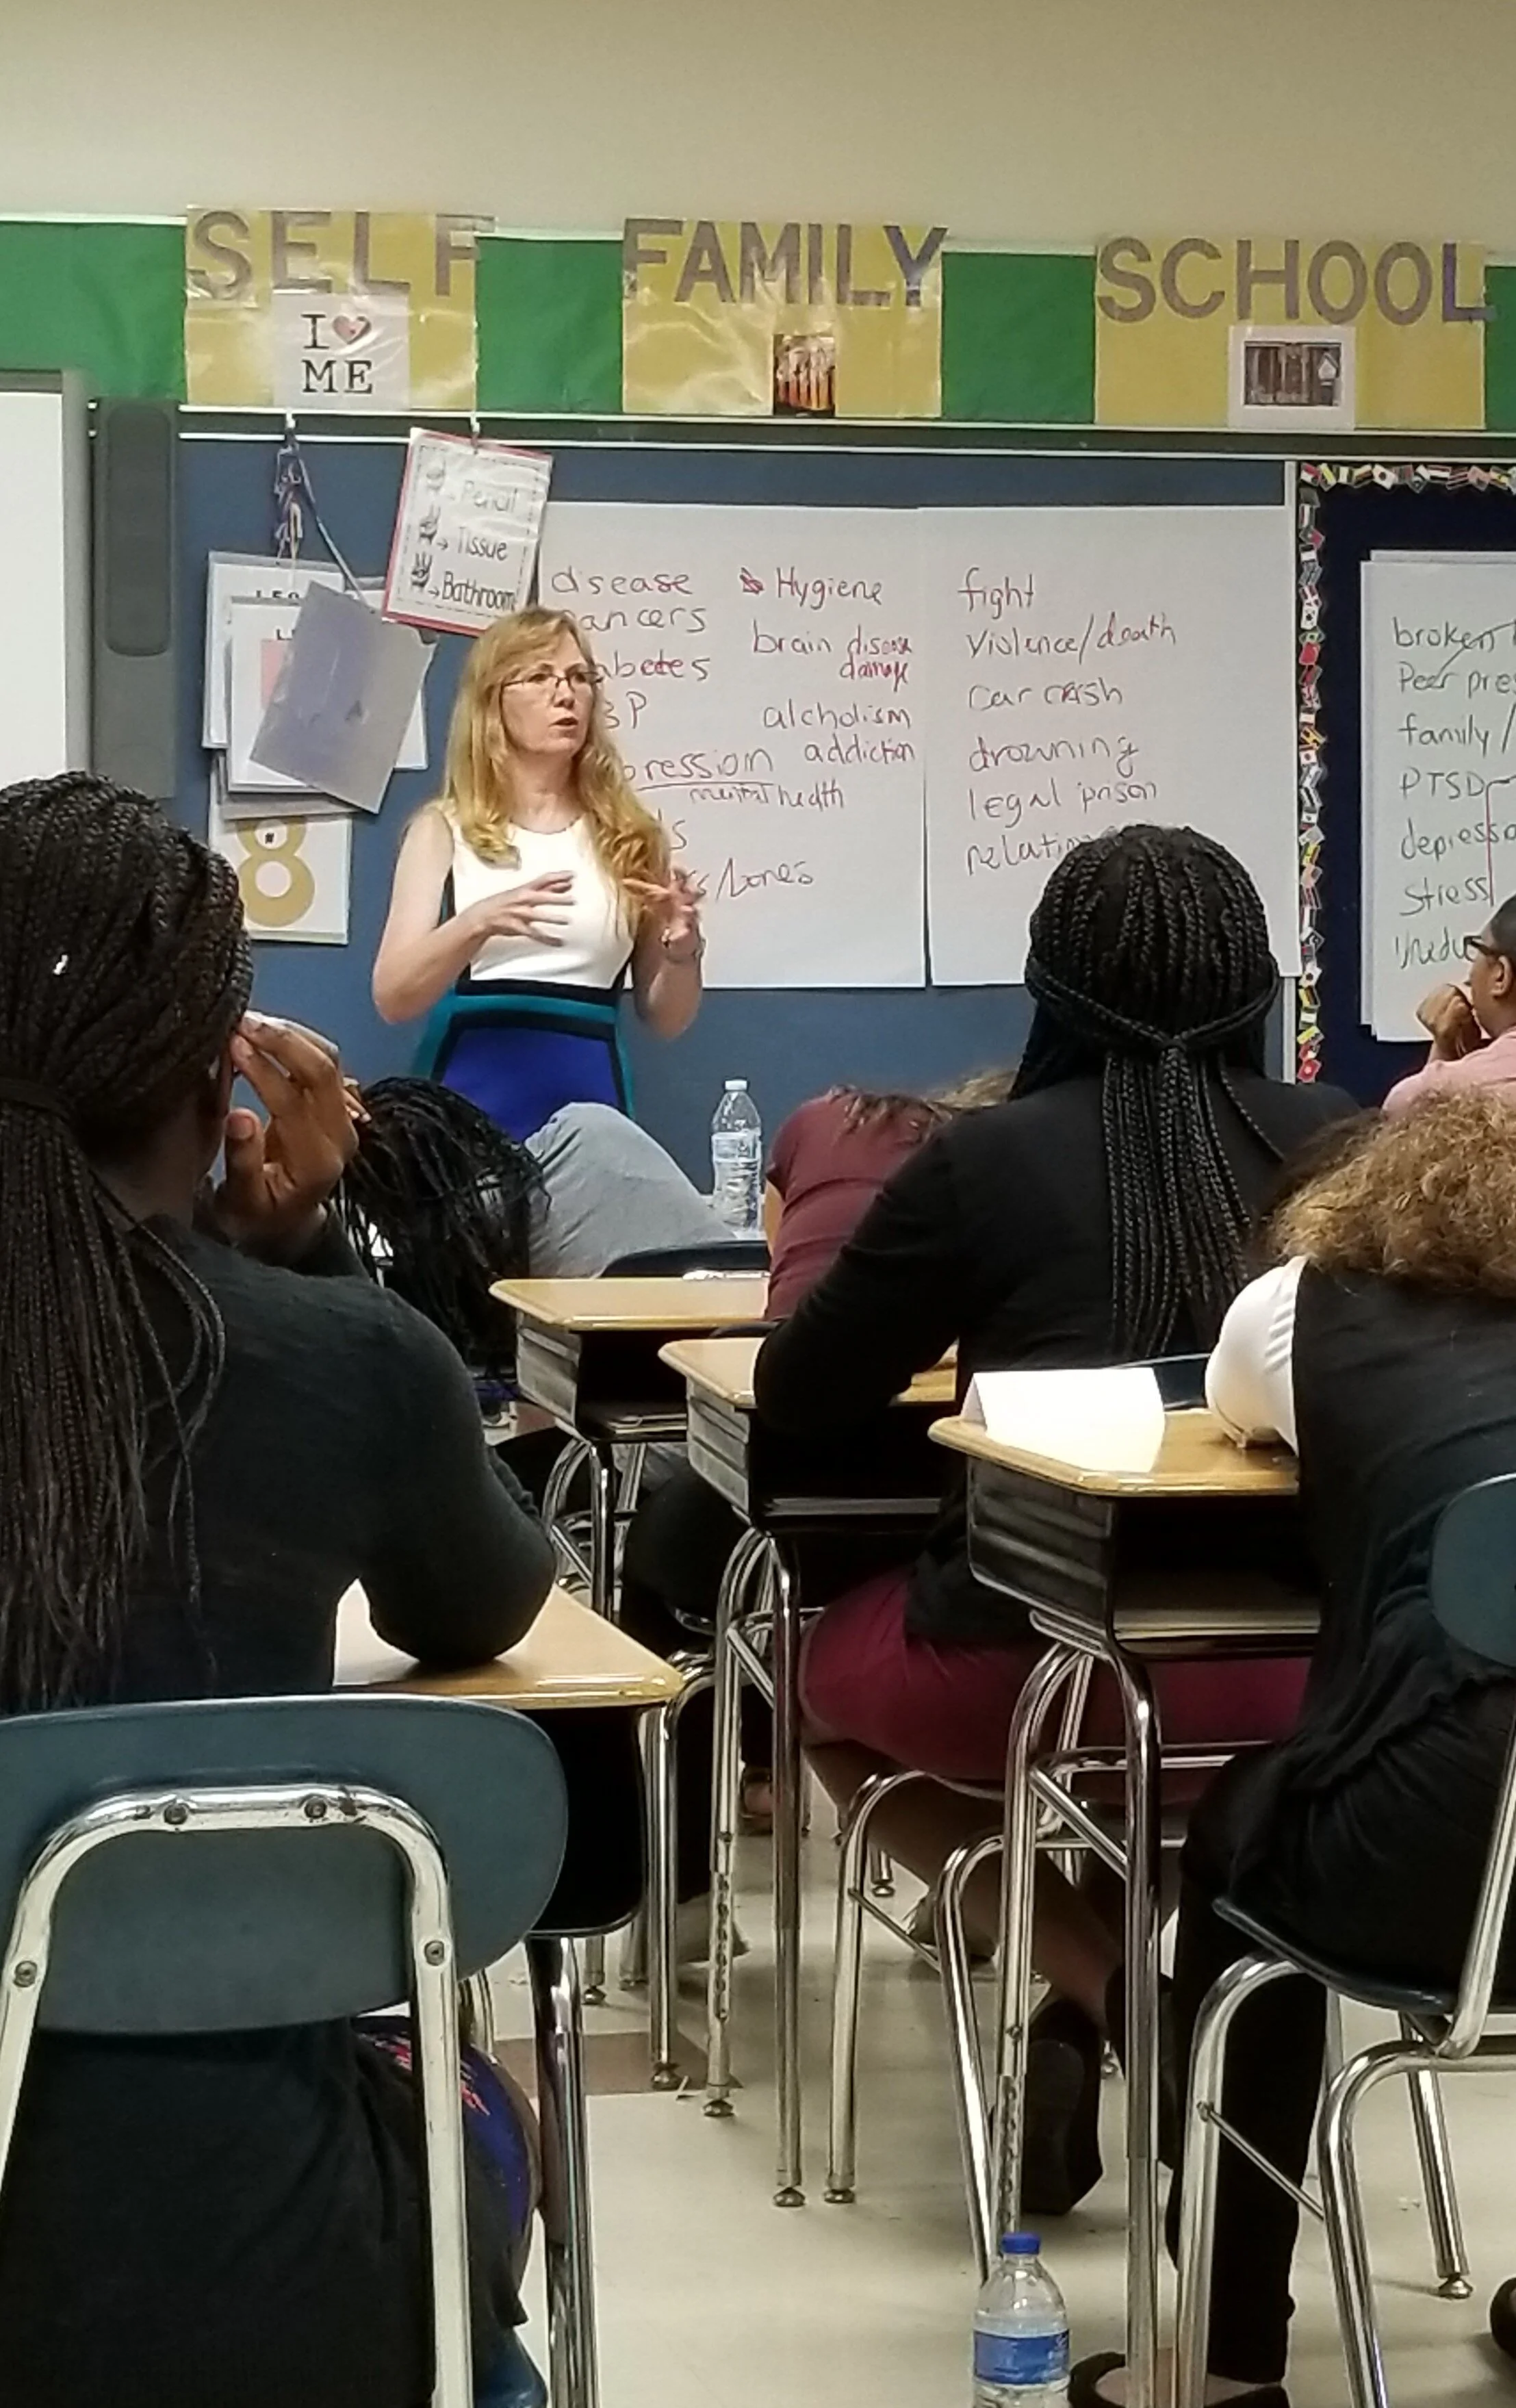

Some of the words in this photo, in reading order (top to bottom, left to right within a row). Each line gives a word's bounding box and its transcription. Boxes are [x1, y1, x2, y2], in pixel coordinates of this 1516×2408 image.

[187, 209, 496, 301] SELF
[624, 217, 948, 307] FAMILY
[1097, 236, 1496, 325] SCHOOL
[301, 313, 329, 350] I
[302, 360, 373, 394] ME
[457, 526, 509, 561] Tissue
[442, 570, 516, 611] Bathroom
[776, 566, 882, 611] Hygiene
[957, 567, 1035, 619] fight
[561, 607, 706, 633] ancers
[753, 619, 832, 654] brain
[1399, 766, 1486, 800] PTSD
